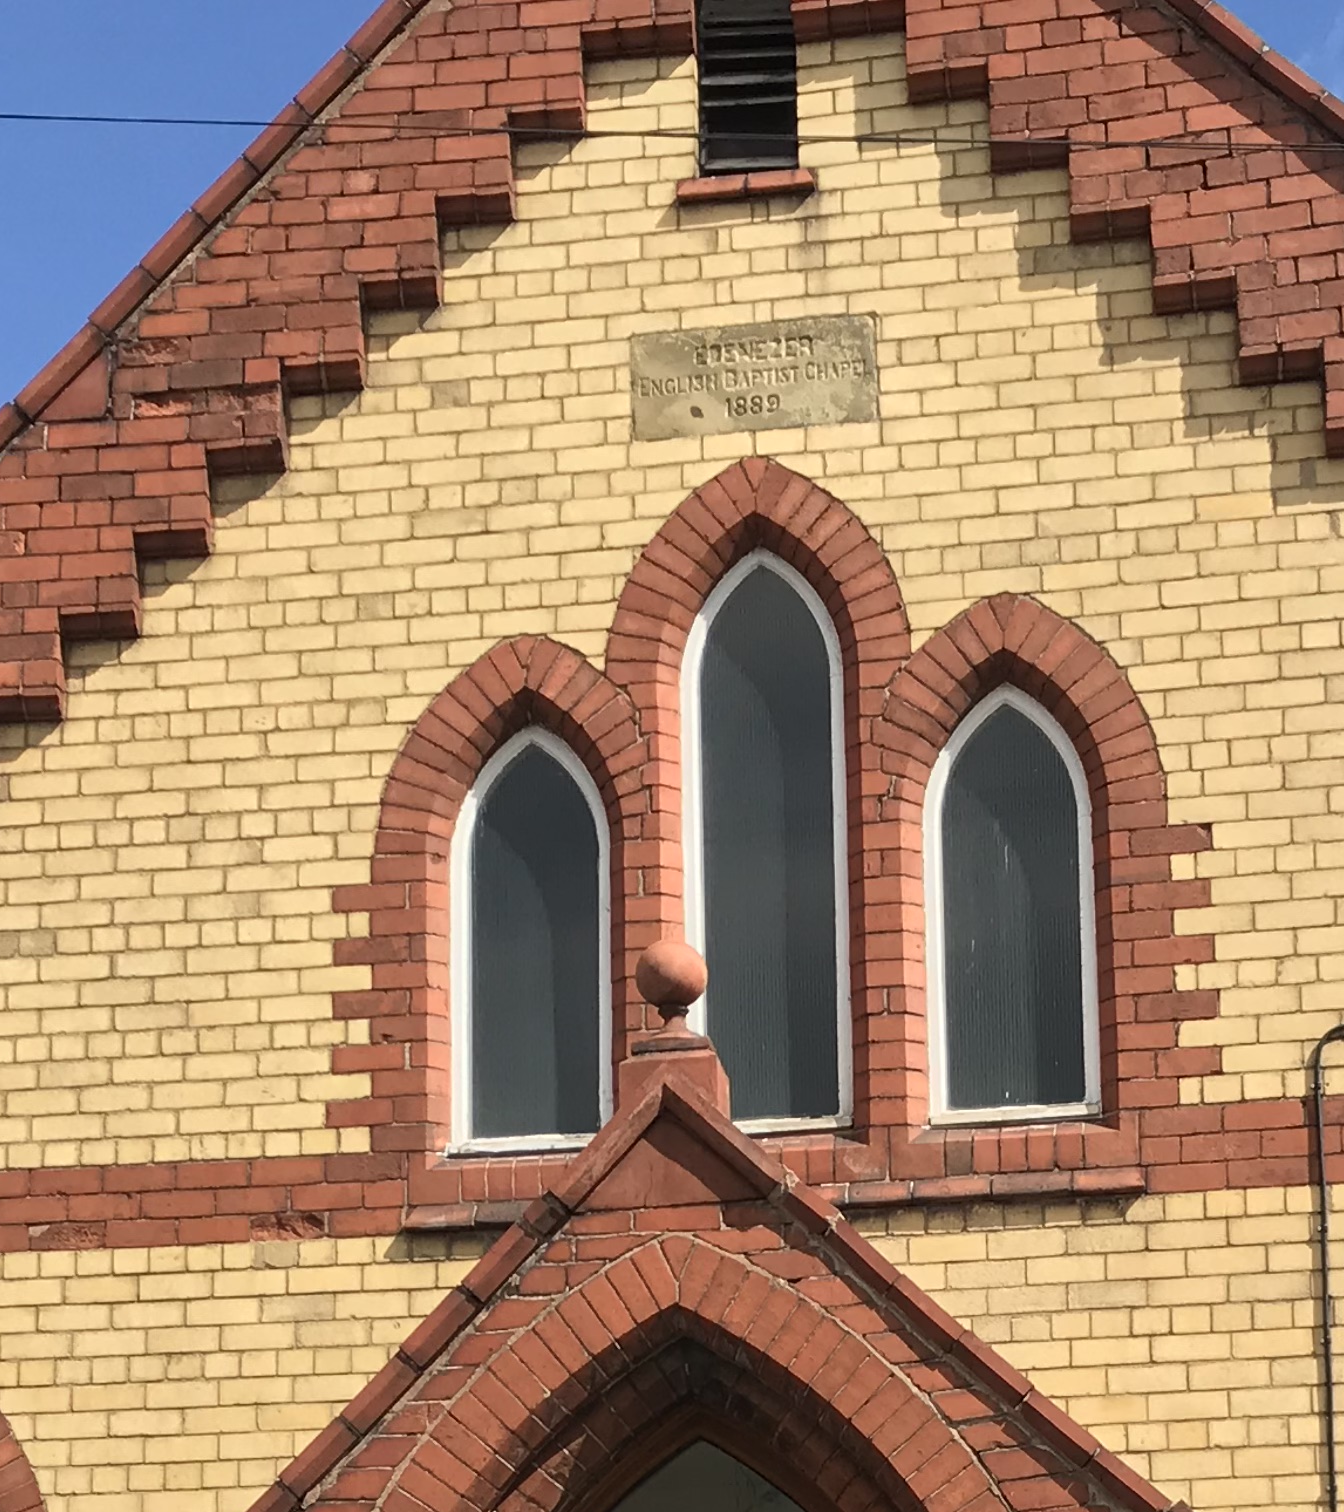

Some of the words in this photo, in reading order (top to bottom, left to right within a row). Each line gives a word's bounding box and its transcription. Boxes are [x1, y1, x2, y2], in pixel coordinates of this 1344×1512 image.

[638, 374, 718, 398] ENGLISH
[722, 365, 799, 392] BAPTIST
[724, 393, 781, 418] 1889
